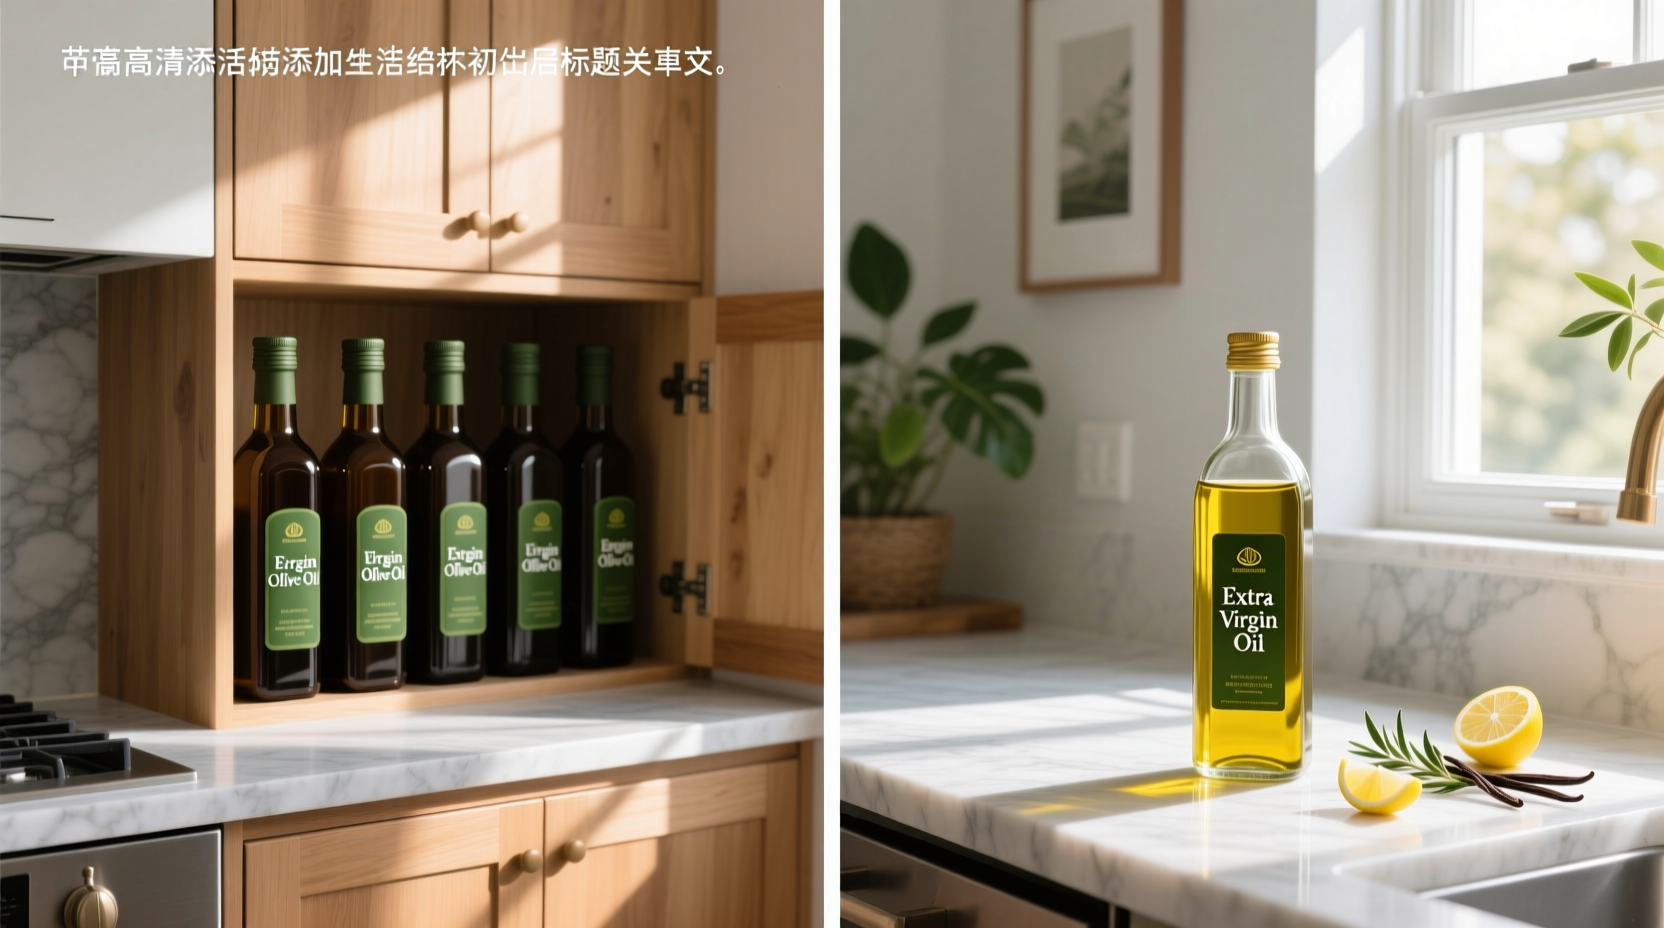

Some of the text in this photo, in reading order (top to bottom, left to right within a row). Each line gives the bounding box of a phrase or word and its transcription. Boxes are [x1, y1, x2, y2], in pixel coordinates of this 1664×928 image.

[1221, 586, 1275, 606] Extra
[1219, 609, 1278, 634] Virgin
[1233, 632, 1265, 653] Oil
